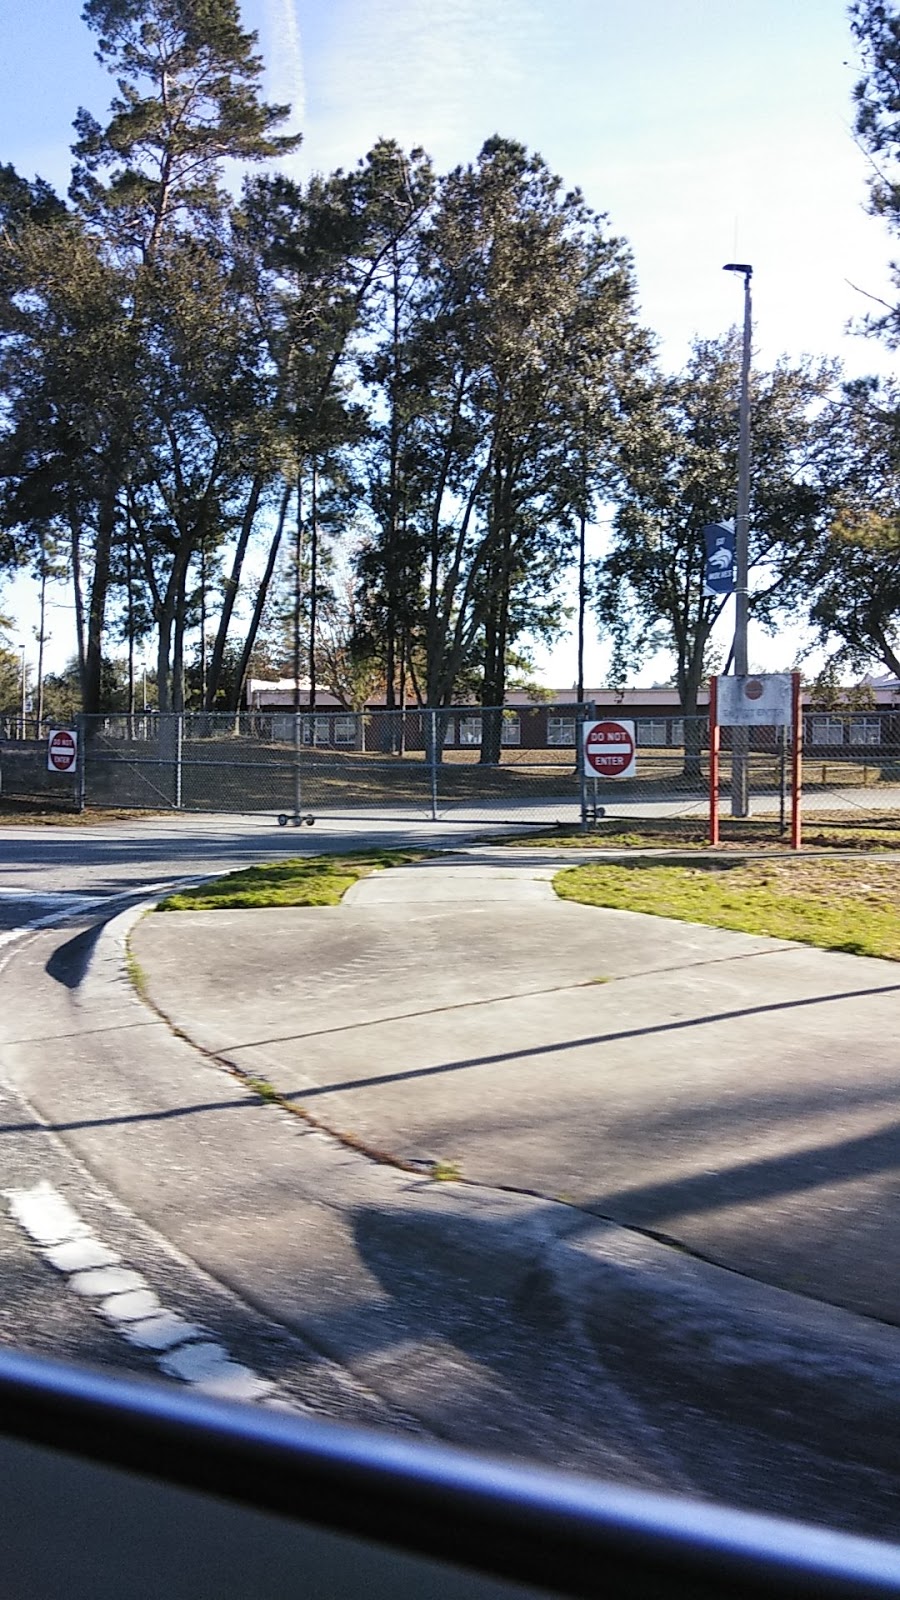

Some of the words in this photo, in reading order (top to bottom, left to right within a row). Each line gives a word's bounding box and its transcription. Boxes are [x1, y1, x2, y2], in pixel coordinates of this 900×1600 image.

[590, 732, 605, 742] DO
[607, 731, 627, 741] NOT
[594, 756, 625, 766] ENTER
